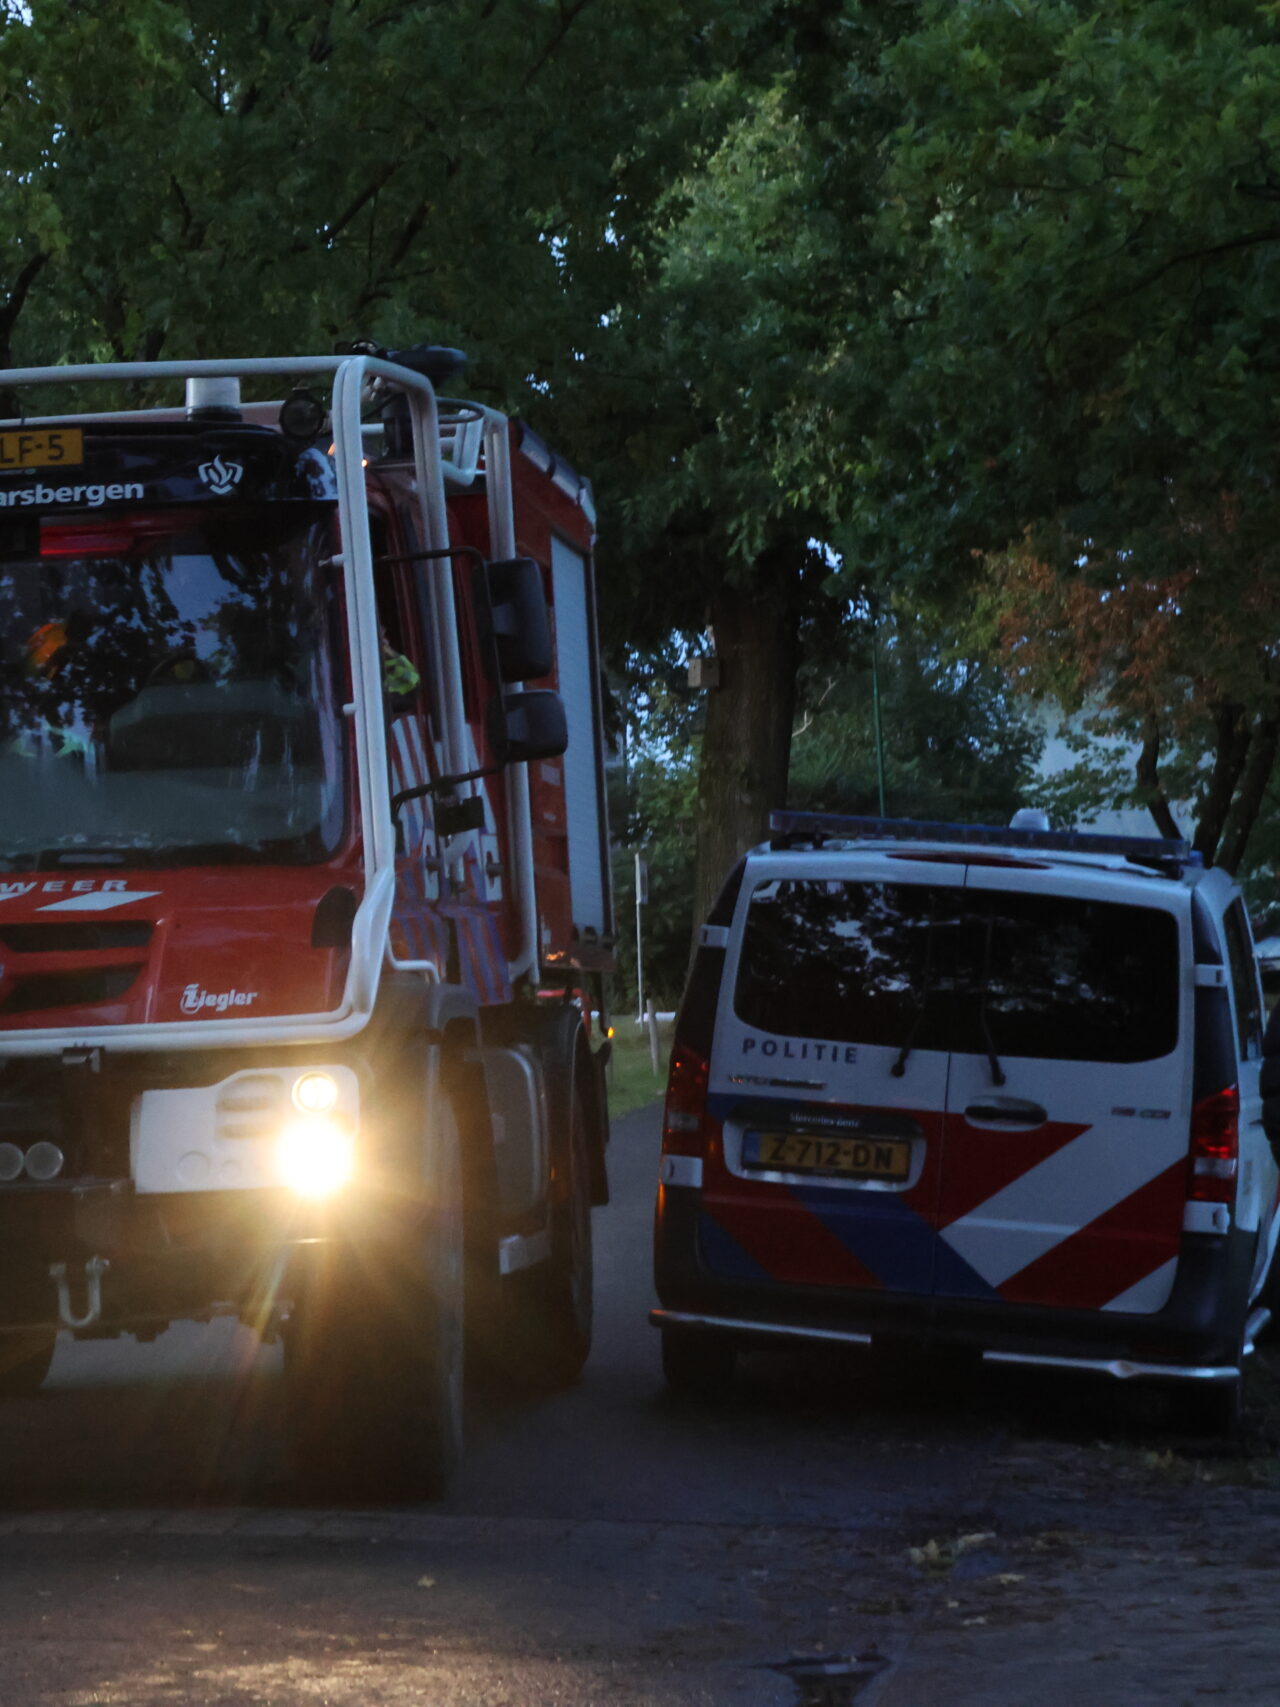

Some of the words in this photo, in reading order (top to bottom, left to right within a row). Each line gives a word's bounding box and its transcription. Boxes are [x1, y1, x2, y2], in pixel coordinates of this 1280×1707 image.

[180, 983, 259, 1016] Ziegler
[742, 1037, 858, 1064] POLITIE
[769, 1136, 893, 1171] Z-712-DN
